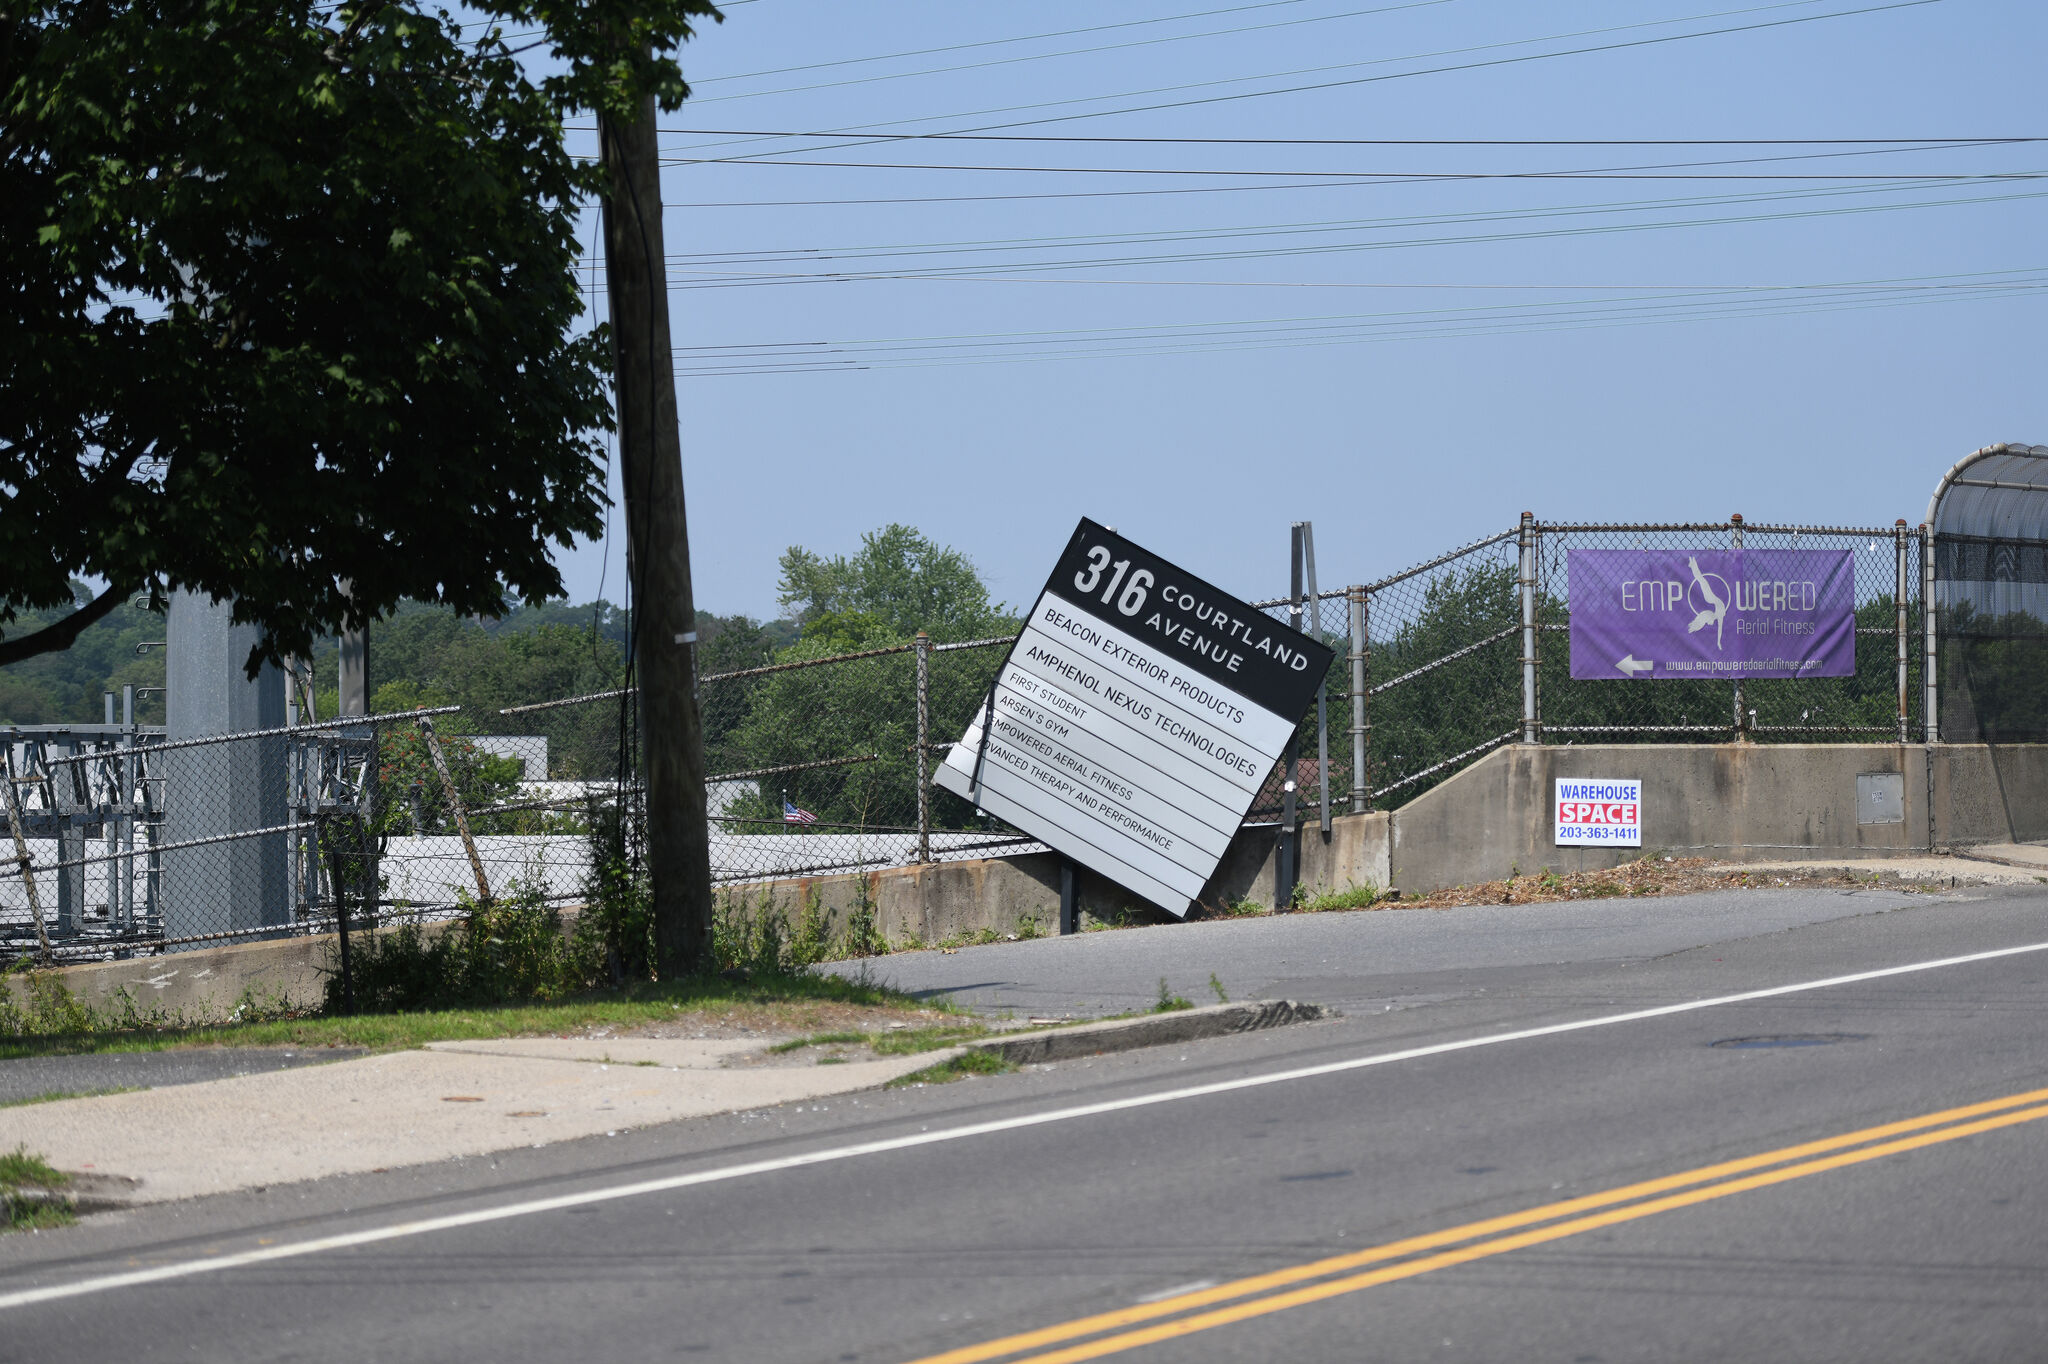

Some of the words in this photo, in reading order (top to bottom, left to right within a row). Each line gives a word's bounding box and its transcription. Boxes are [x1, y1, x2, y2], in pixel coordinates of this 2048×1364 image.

[1074, 545, 1155, 617] 316
[1621, 580, 1816, 611] EMPOWERED
[1145, 613, 1244, 672] AVENUE
[1162, 586, 1308, 671] COURTLAND
[1737, 618, 1769, 635] Aerial
[1774, 618, 1815, 635] Fitness
[1044, 609, 1101, 647] BEACON
[1102, 640, 1169, 684] EXTERIOR
[1170, 677, 1244, 724] PRODUCTS
[1666, 658, 1822, 673] www.empoweredaerialfitness.com
[1000, 695, 1045, 725] ARSEN'S
[1045, 719, 1069, 738] GYM
[1010, 673, 1039, 694] FIRST
[1040, 689, 1087, 720] STUDENT
[1027, 646, 1100, 694] AMPHENOL
[1104, 686, 1153, 721] NEXUS
[1154, 713, 1257, 777] TECHNOLOGIES
[1053, 752, 1088, 778] AERIAL
[1090, 771, 1133, 801] FITNESS
[1560, 785, 1637, 800] WAREHOUSE
[1030, 765, 1076, 796] THERAPY
[1076, 792, 1098, 809] AND
[1099, 804, 1174, 851] PERFORMANCE
[1562, 804, 1634, 824] SPACE
[1560, 827, 1637, 839] 203-363-1411
